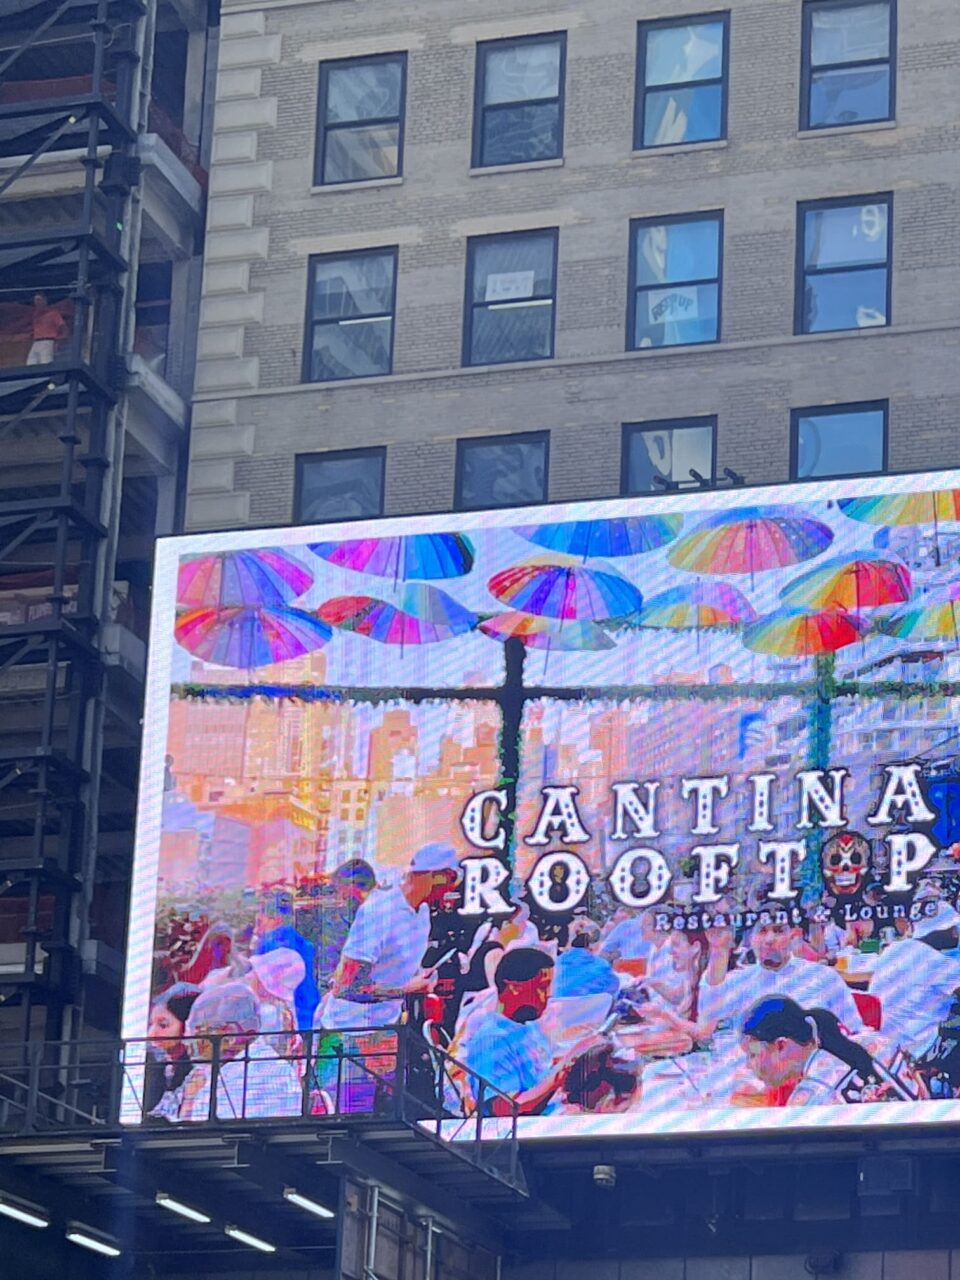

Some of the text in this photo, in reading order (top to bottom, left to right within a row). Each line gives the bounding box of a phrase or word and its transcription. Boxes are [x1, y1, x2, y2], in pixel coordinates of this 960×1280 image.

[459, 763, 938, 850] CANTINA
[655, 900, 939, 930] Restaurant & Lounge
